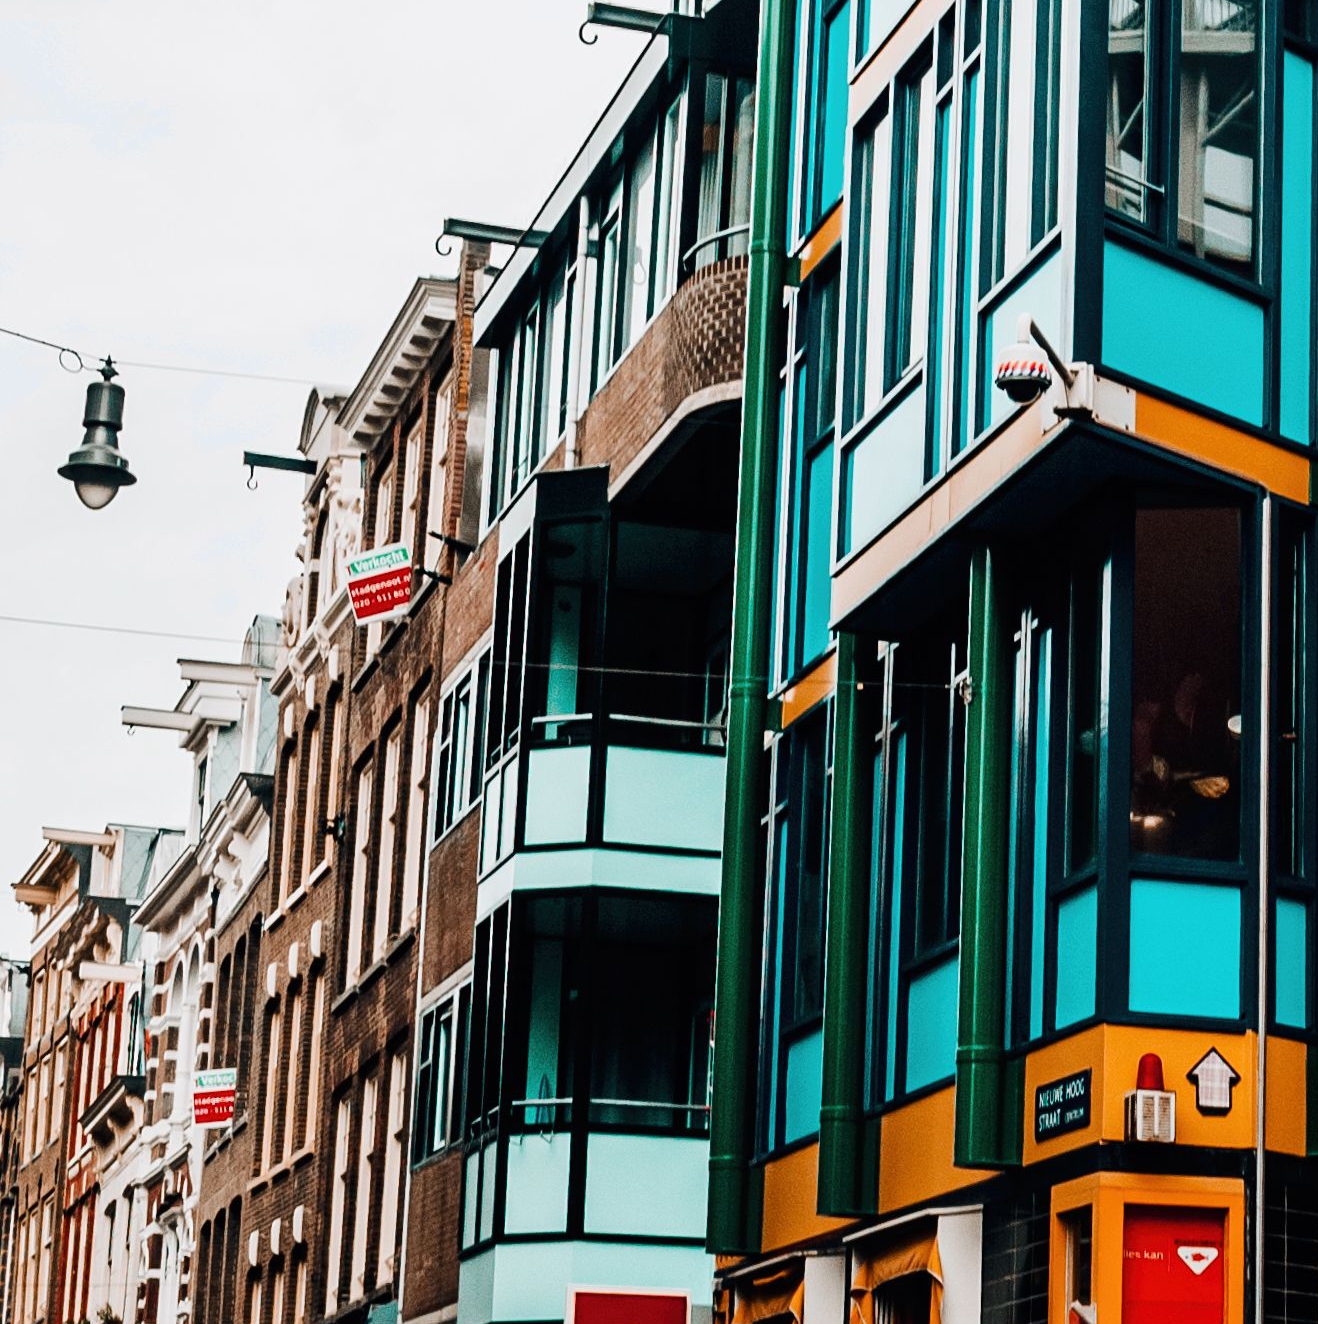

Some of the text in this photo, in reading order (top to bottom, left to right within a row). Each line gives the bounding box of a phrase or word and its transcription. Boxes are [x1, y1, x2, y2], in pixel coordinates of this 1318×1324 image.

[353, 550, 405, 574] Verkocht
[1039, 1077, 1085, 1108] NIEUWE HOOG
[1039, 1108, 1061, 1132] STRAAT
[1143, 1249, 1164, 1261] kan
